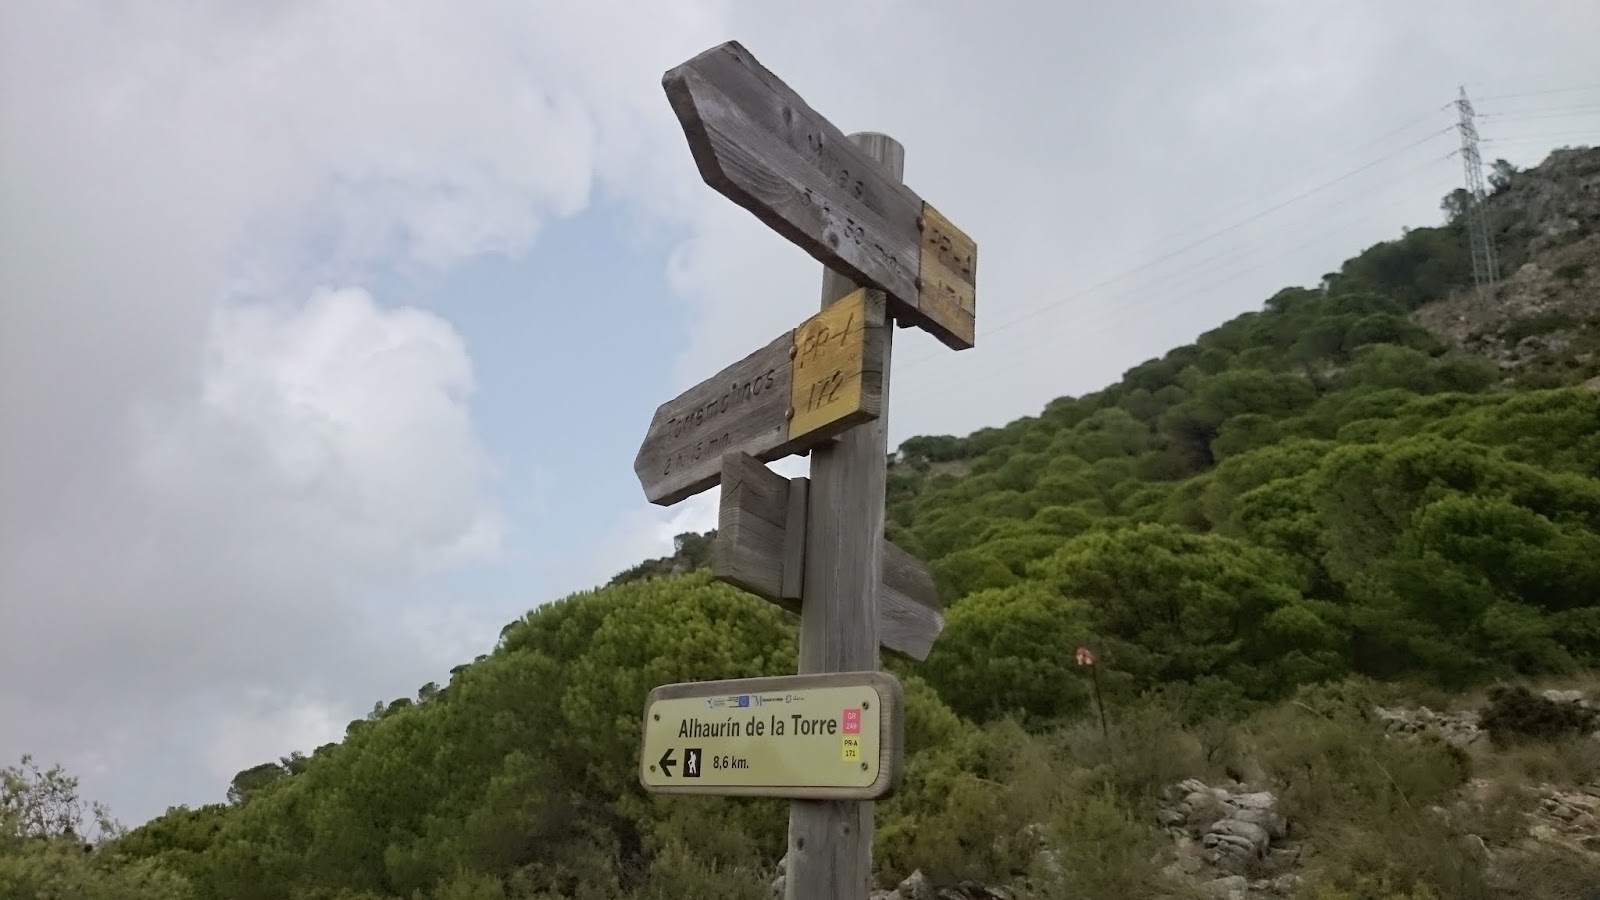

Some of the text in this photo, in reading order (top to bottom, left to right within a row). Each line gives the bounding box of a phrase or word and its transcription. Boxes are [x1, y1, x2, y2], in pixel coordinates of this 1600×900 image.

[843, 217, 865, 246] 30
[806, 369, 844, 414] 172
[663, 458, 672, 476] 2
[847, 712, 857, 720] GR
[678, 713, 837, 738] Alhaurín de la Torre
[844, 739, 858, 747] PR-A
[713, 753, 750, 771] 8,6 km.
[845, 749, 856, 757] 171
